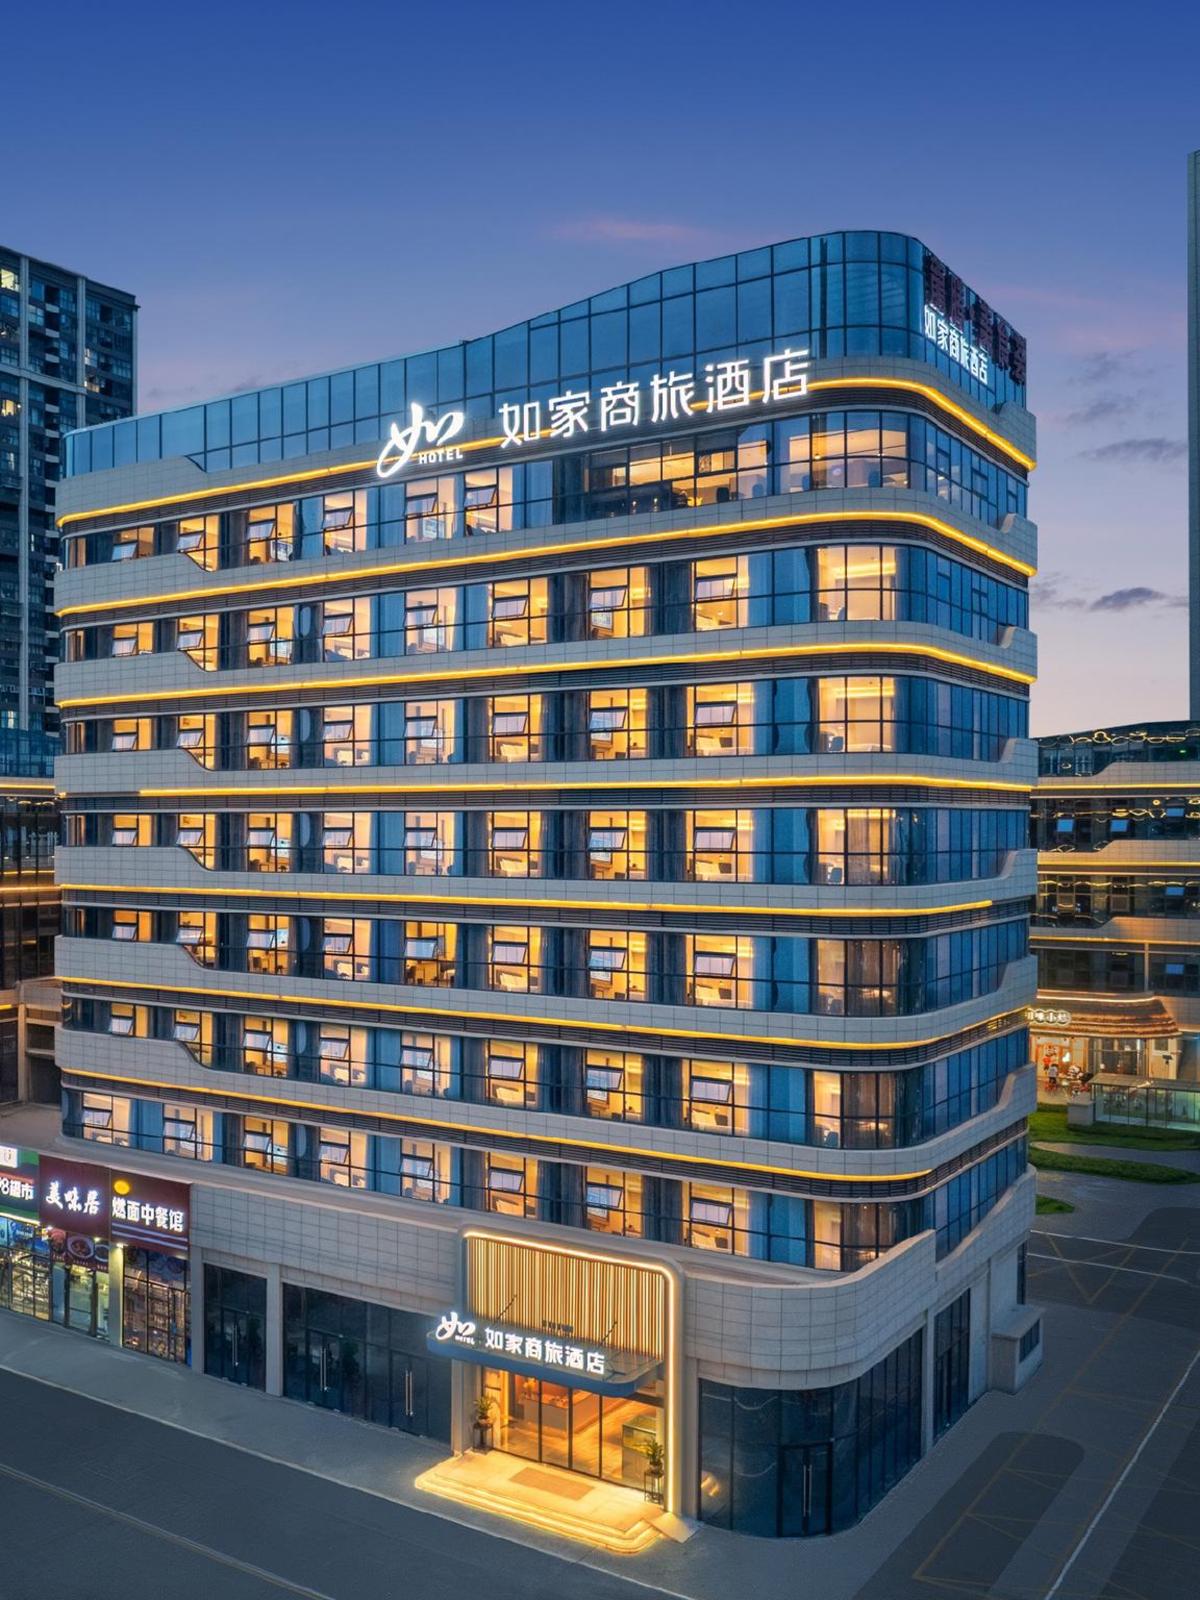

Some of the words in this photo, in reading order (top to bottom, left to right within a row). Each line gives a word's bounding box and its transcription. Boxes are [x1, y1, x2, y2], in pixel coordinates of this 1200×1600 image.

[924, 303, 988, 385] 如家商旅酒店
[499, 349, 809, 448] 如家商旅酒店
[419, 447, 464, 464] HOTEL
[45, 1181, 100, 1216] 美味居
[112, 1197, 184, 1232] 燃面中餐馆
[485, 1327, 605, 1375] 如家商旅酒店
